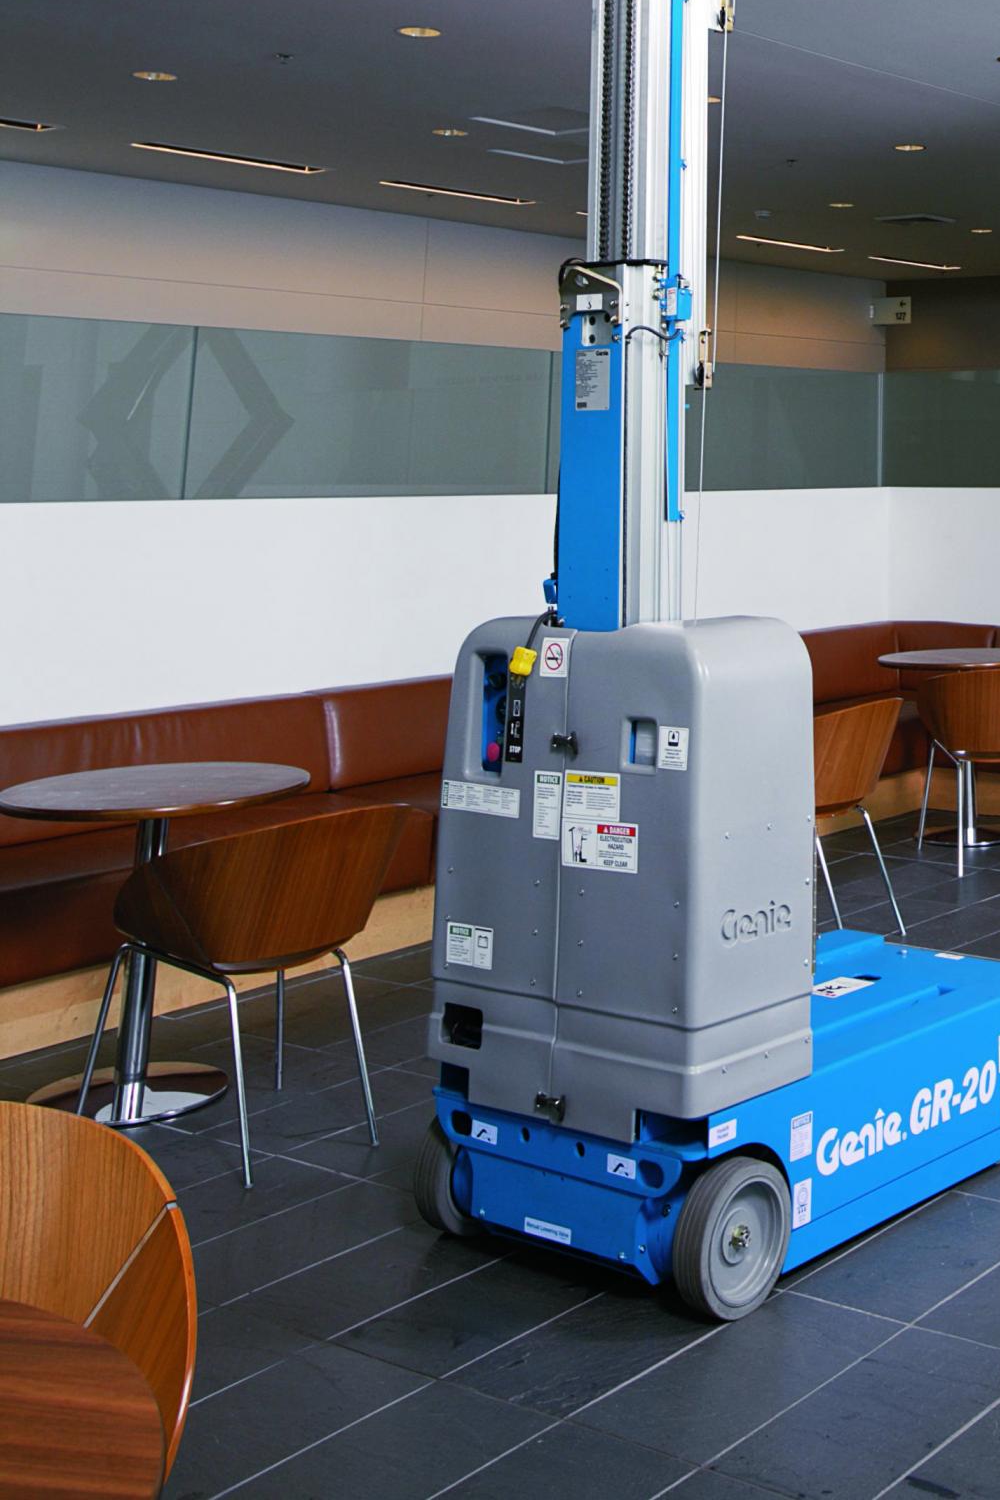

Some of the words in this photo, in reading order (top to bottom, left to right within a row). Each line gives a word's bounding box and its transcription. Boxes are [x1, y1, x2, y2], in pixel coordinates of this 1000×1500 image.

[721, 900, 791, 948] Genie
[816, 1108, 902, 1176] Genie
[910, 1059, 997, 1135] GR-20
